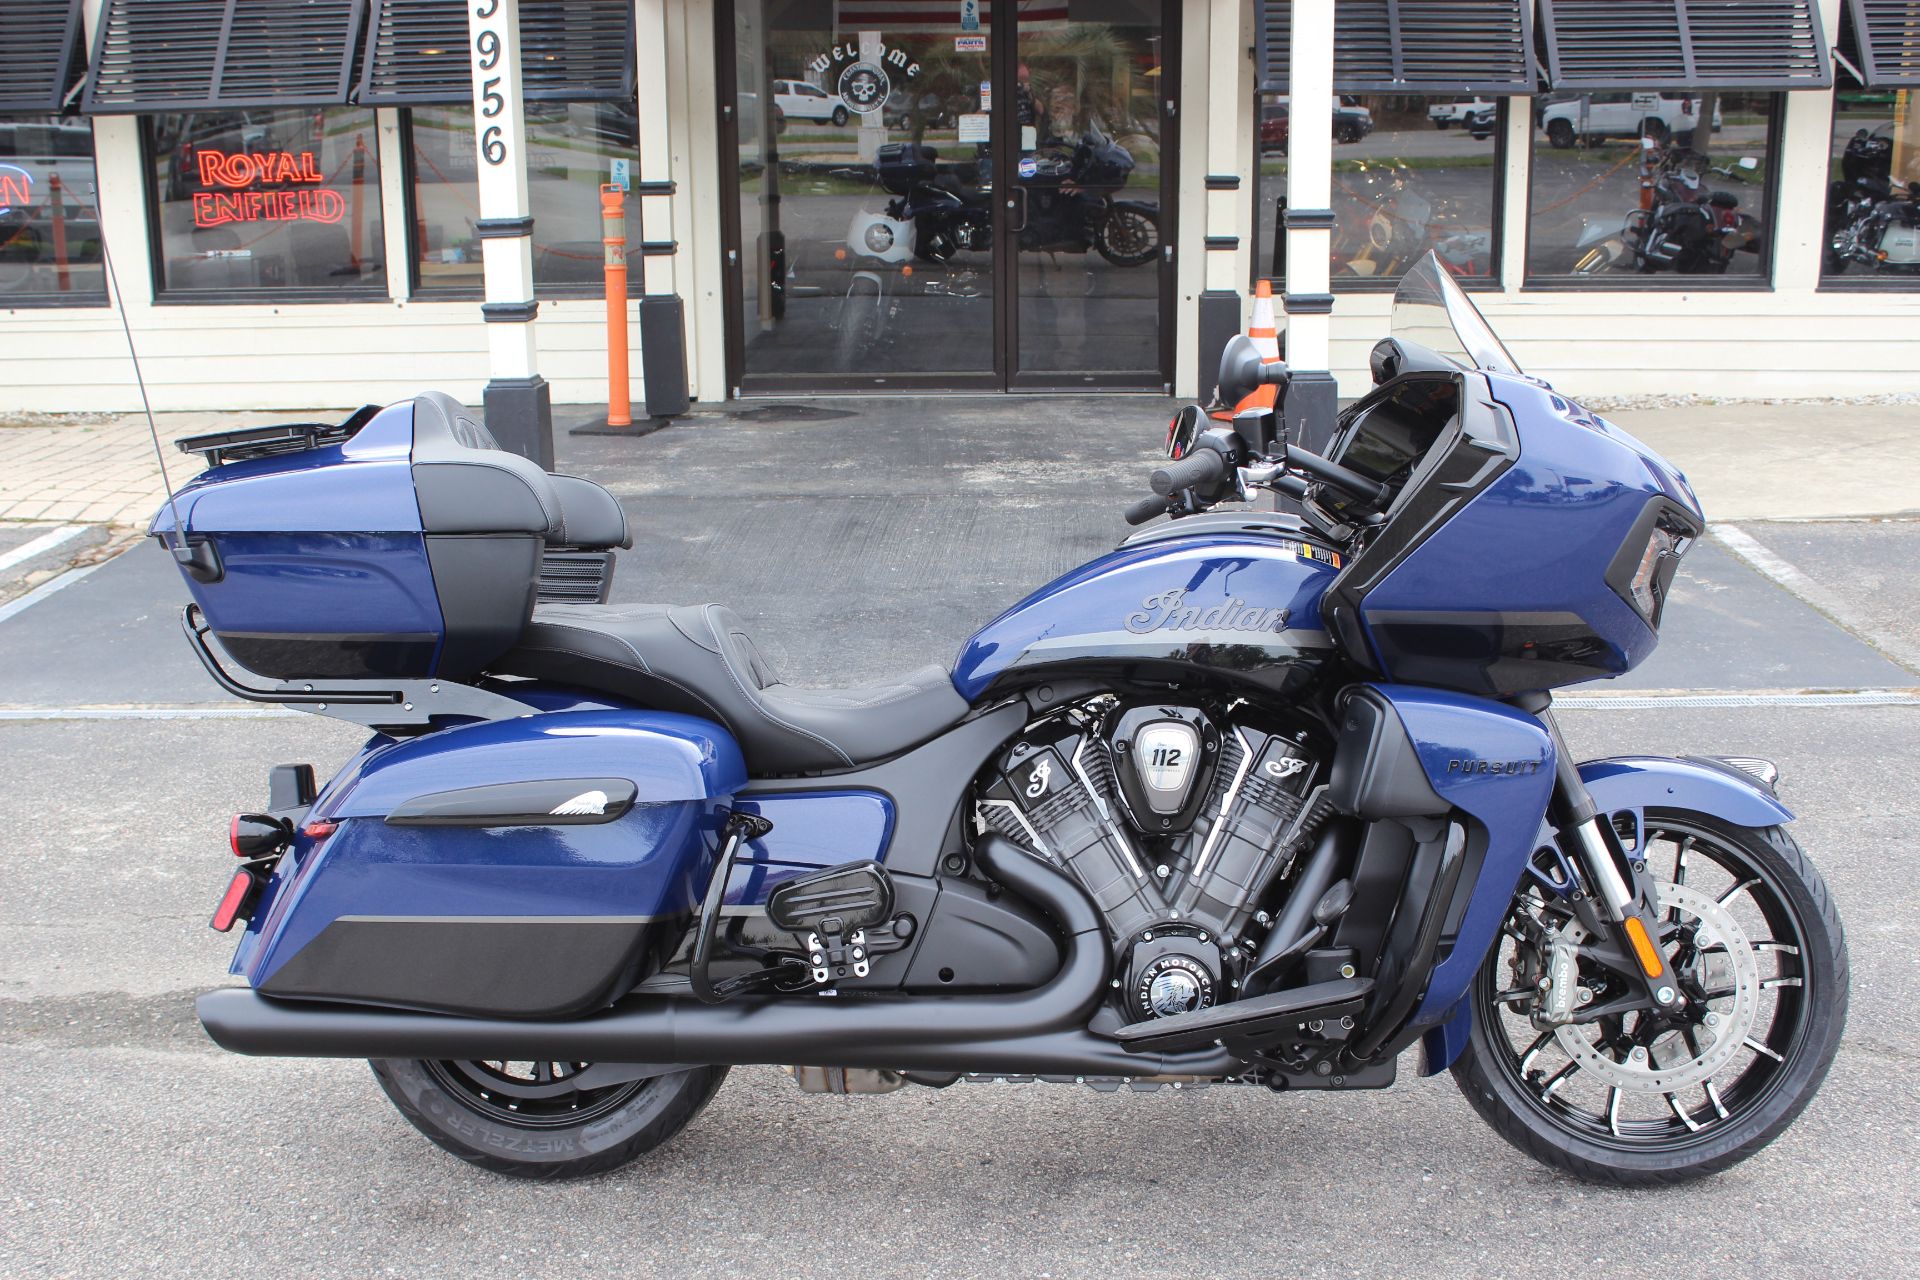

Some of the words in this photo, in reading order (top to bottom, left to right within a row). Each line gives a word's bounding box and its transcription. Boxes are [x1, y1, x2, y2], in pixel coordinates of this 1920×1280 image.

[197, 150, 324, 188] ROYAL
[193, 189, 345, 228] ENFIELD
[1123, 588, 1290, 634] Indian
[1152, 748, 1182, 766] 112
[1447, 759, 1541, 776] PURSUIT
[1140, 967, 1158, 1015] INDIAN
[1556, 962, 1569, 1008] brembo
[446, 1112, 574, 1154] METZELER
